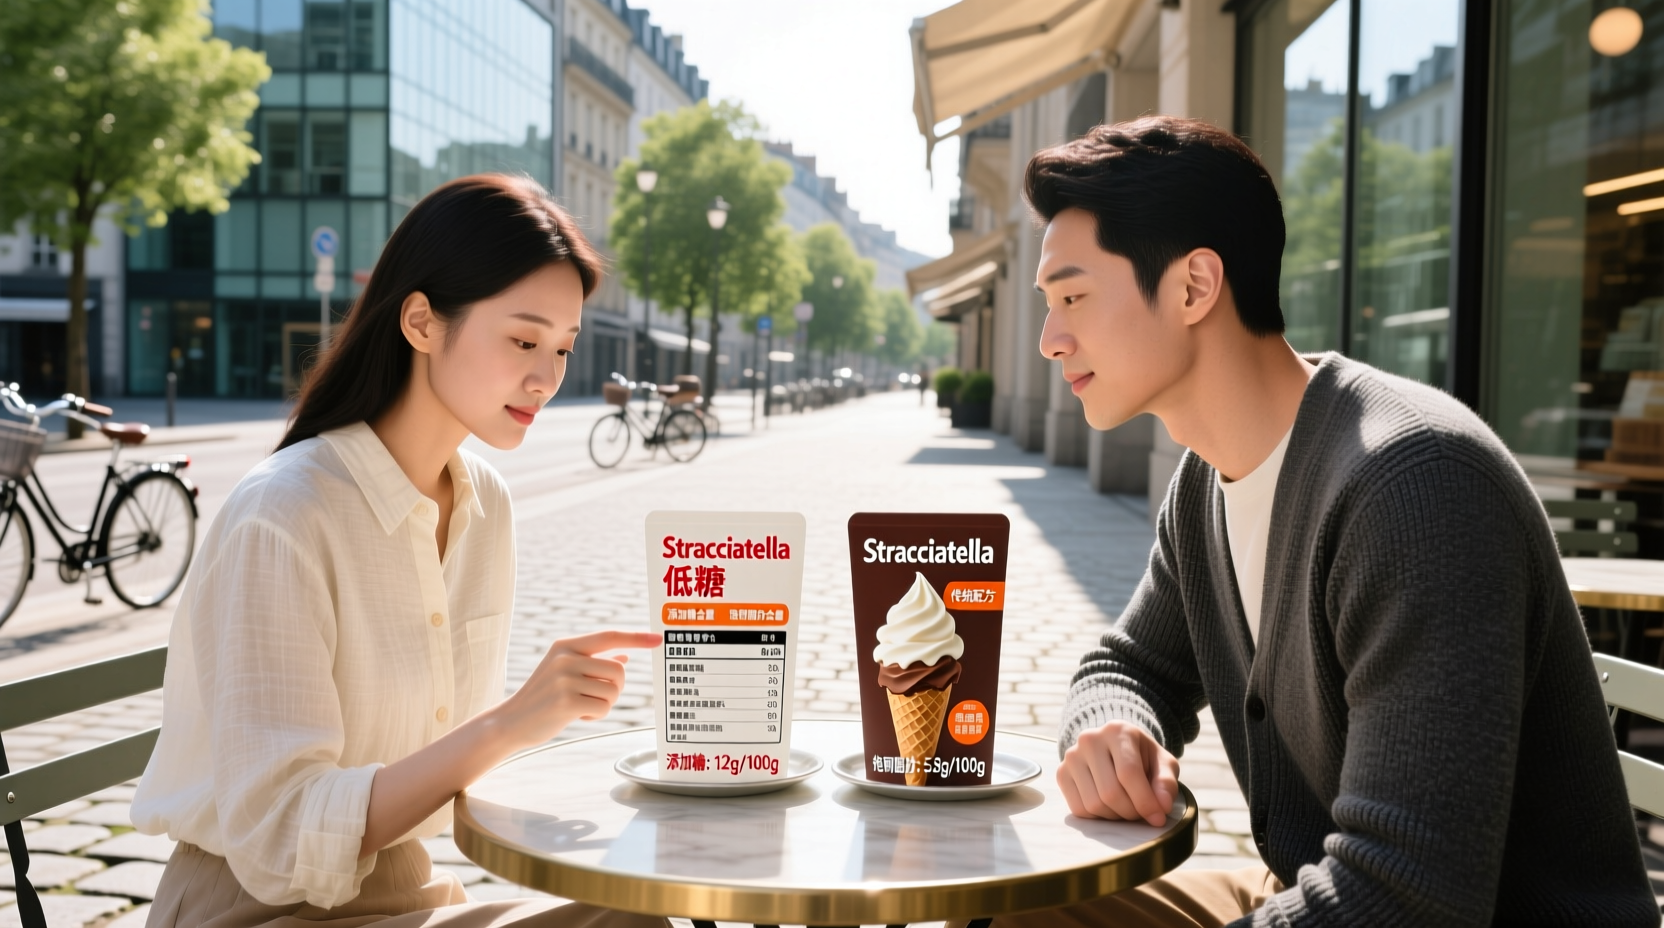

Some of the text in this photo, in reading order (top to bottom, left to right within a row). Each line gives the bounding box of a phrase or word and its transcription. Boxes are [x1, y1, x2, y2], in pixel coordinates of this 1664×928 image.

[662, 535, 790, 560] Stracciatella
[863, 537, 994, 564] Stracciatella
[663, 564, 726, 598] 低糖
[714, 754, 779, 776] 12g/100g
